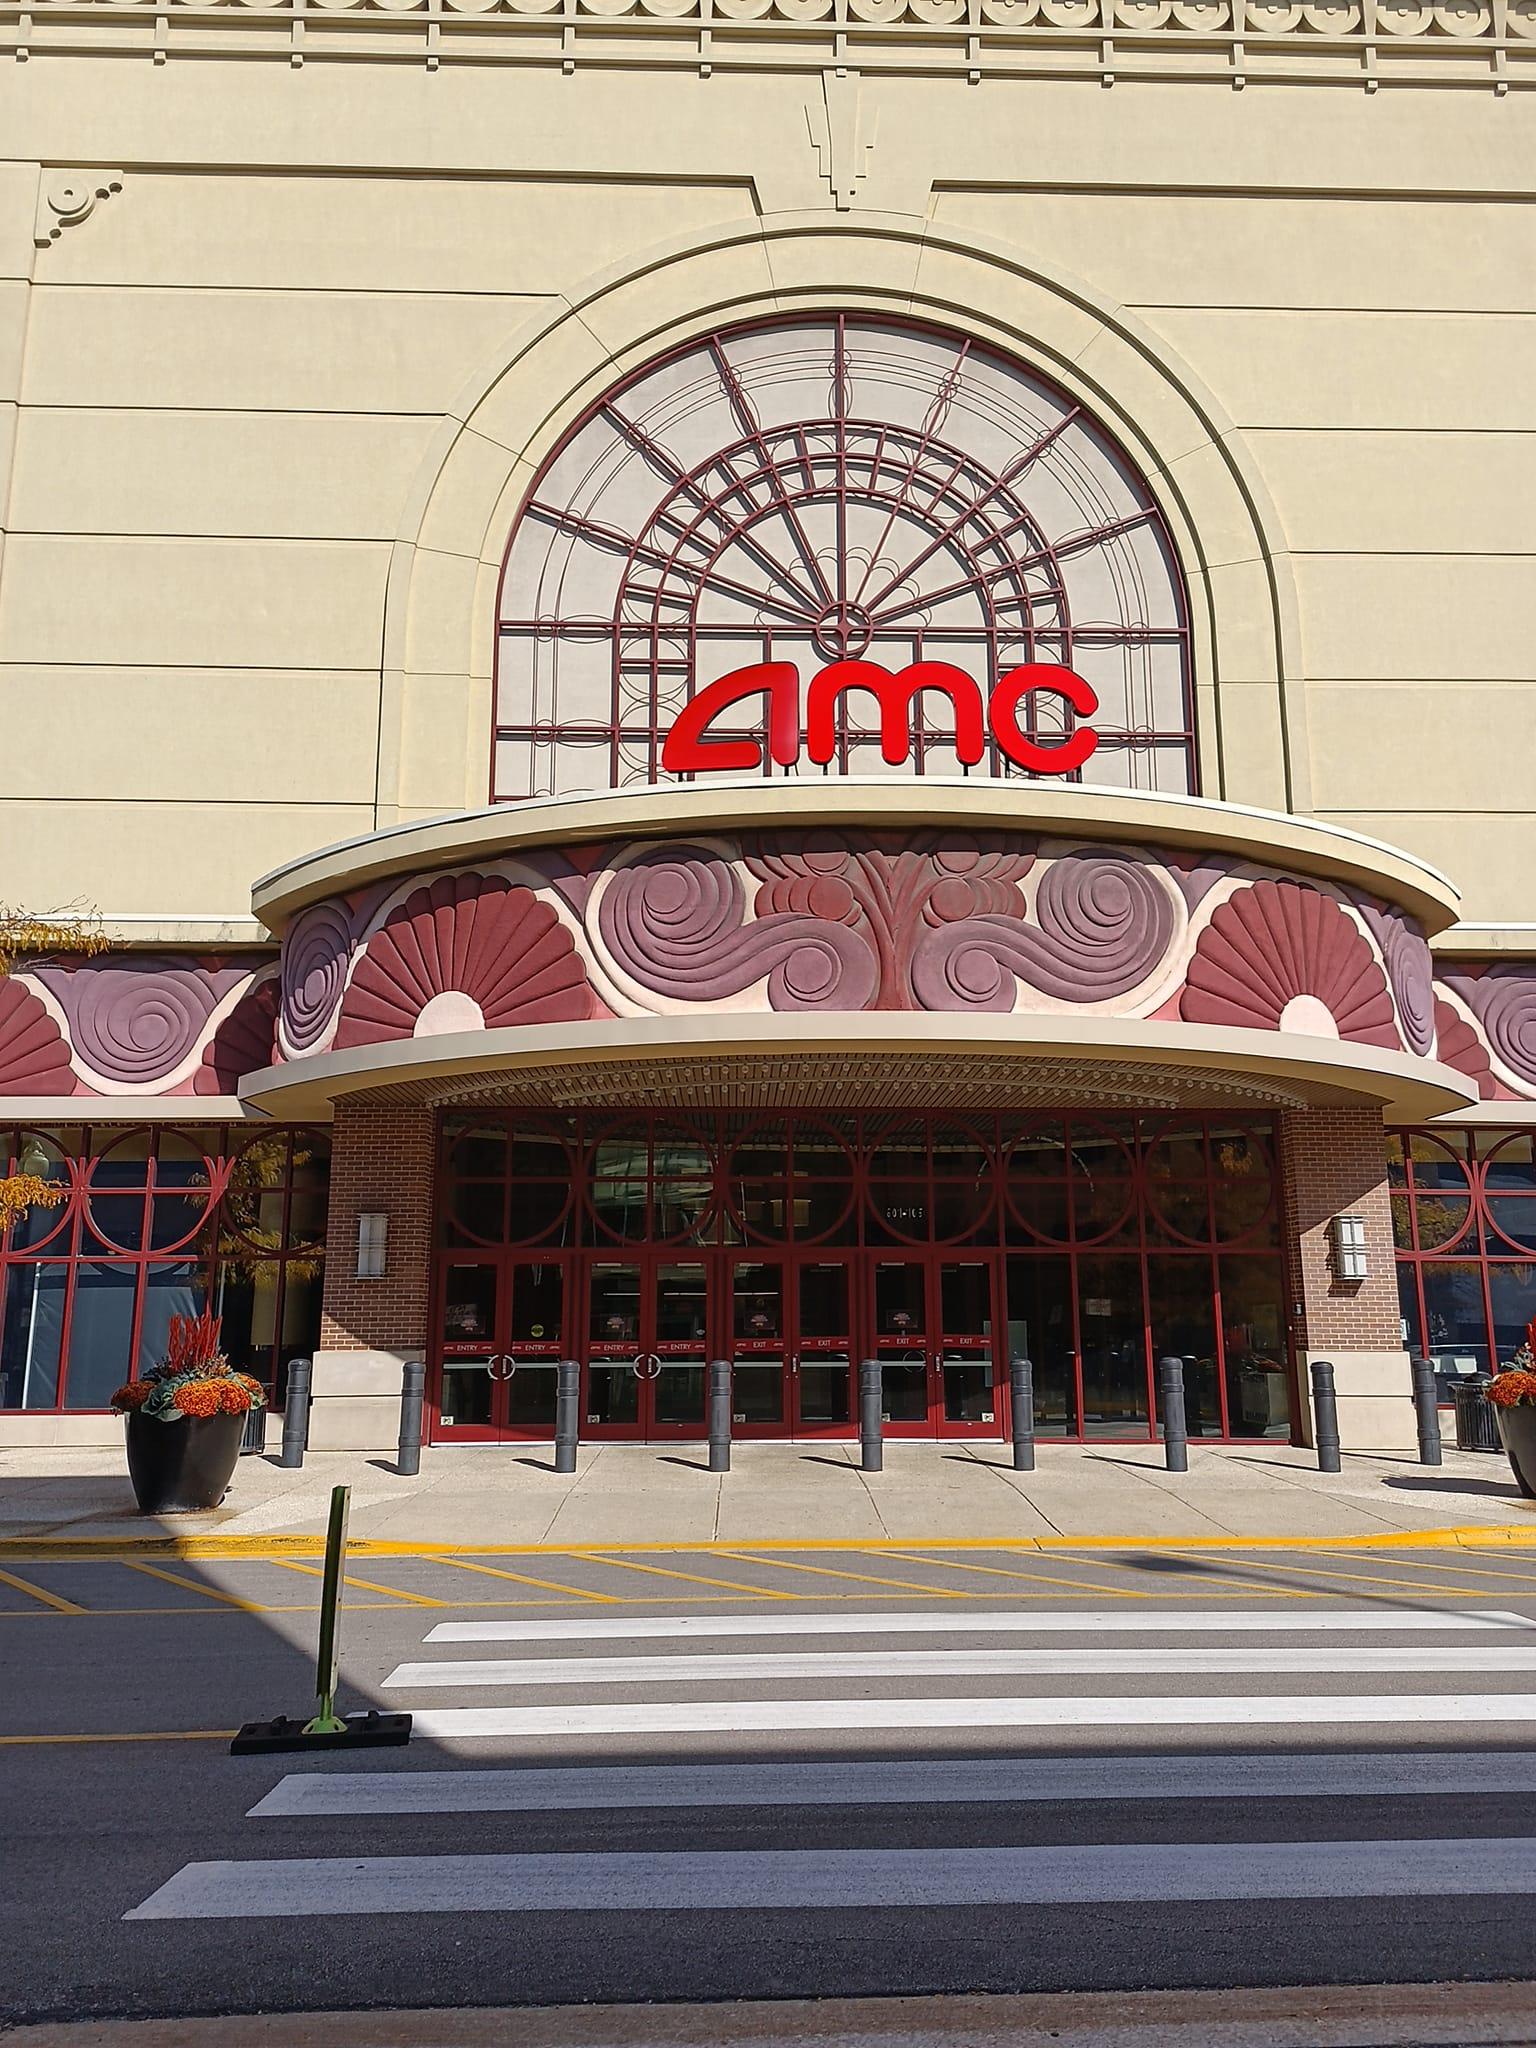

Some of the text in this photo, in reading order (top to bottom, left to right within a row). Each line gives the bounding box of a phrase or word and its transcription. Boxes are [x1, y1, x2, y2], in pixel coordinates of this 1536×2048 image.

[752, 1341, 767, 1349] EXIT
[817, 1339, 832, 1347] EXIT
[896, 1337, 910, 1345] EXIT
[959, 1337, 973, 1345] EXIT
[456, 1344, 478, 1352] ENTRY
[524, 1344, 546, 1352] ENTRY
[670, 1343, 692, 1351] ENTRY
